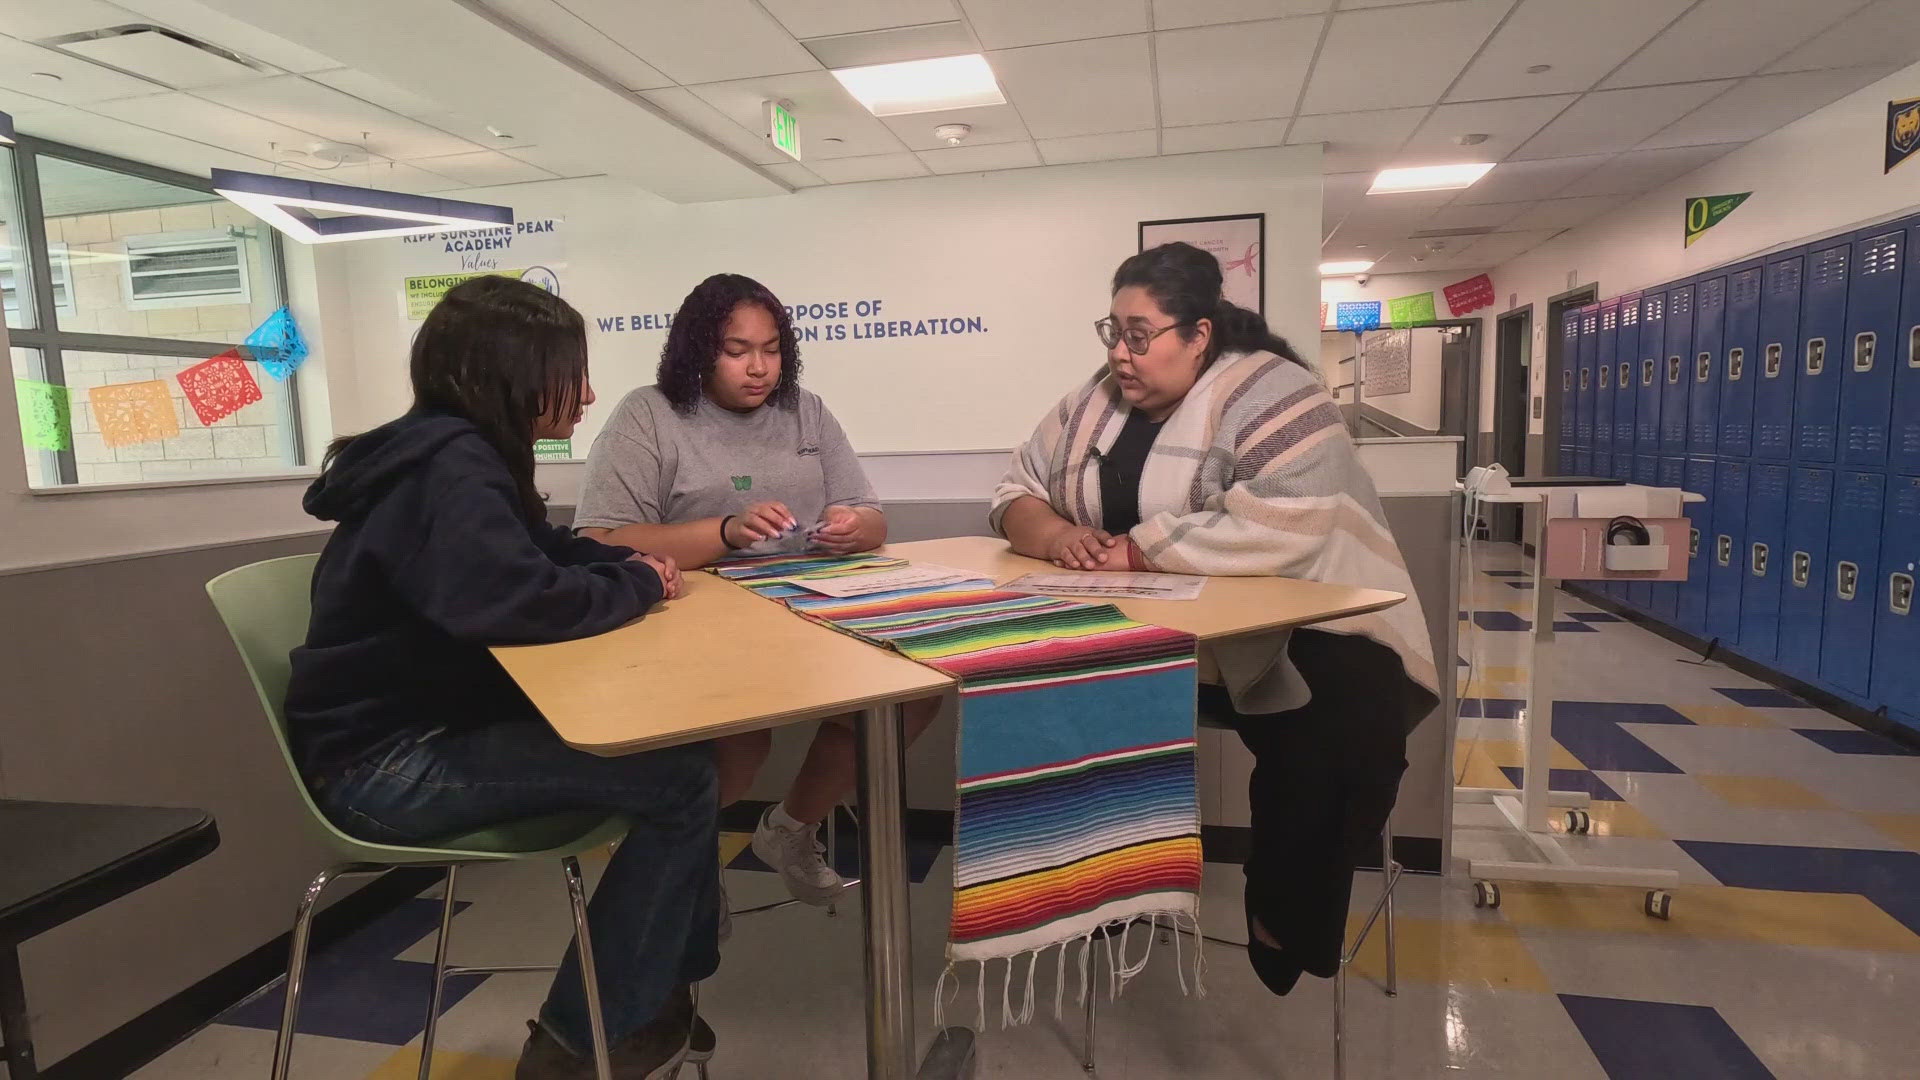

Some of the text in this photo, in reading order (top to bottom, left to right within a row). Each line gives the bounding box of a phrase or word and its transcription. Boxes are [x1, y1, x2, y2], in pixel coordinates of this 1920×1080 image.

[776, 105, 797, 155] EXIT
[1688, 198, 1708, 232] O
[441, 226, 512, 240] SUNSHINE
[517, 220, 554, 234] PEAK
[445, 237, 512, 253] ACADEMY
[461, 252, 498, 271] Values
[410, 277, 467, 290] BELONGIN
[597, 316, 624, 333] WE
[785, 302, 848, 321] RPOSE
[856, 300, 882, 317] OF
[826, 325, 846, 341] IS
[854, 316, 988, 339] LIBERATION.
